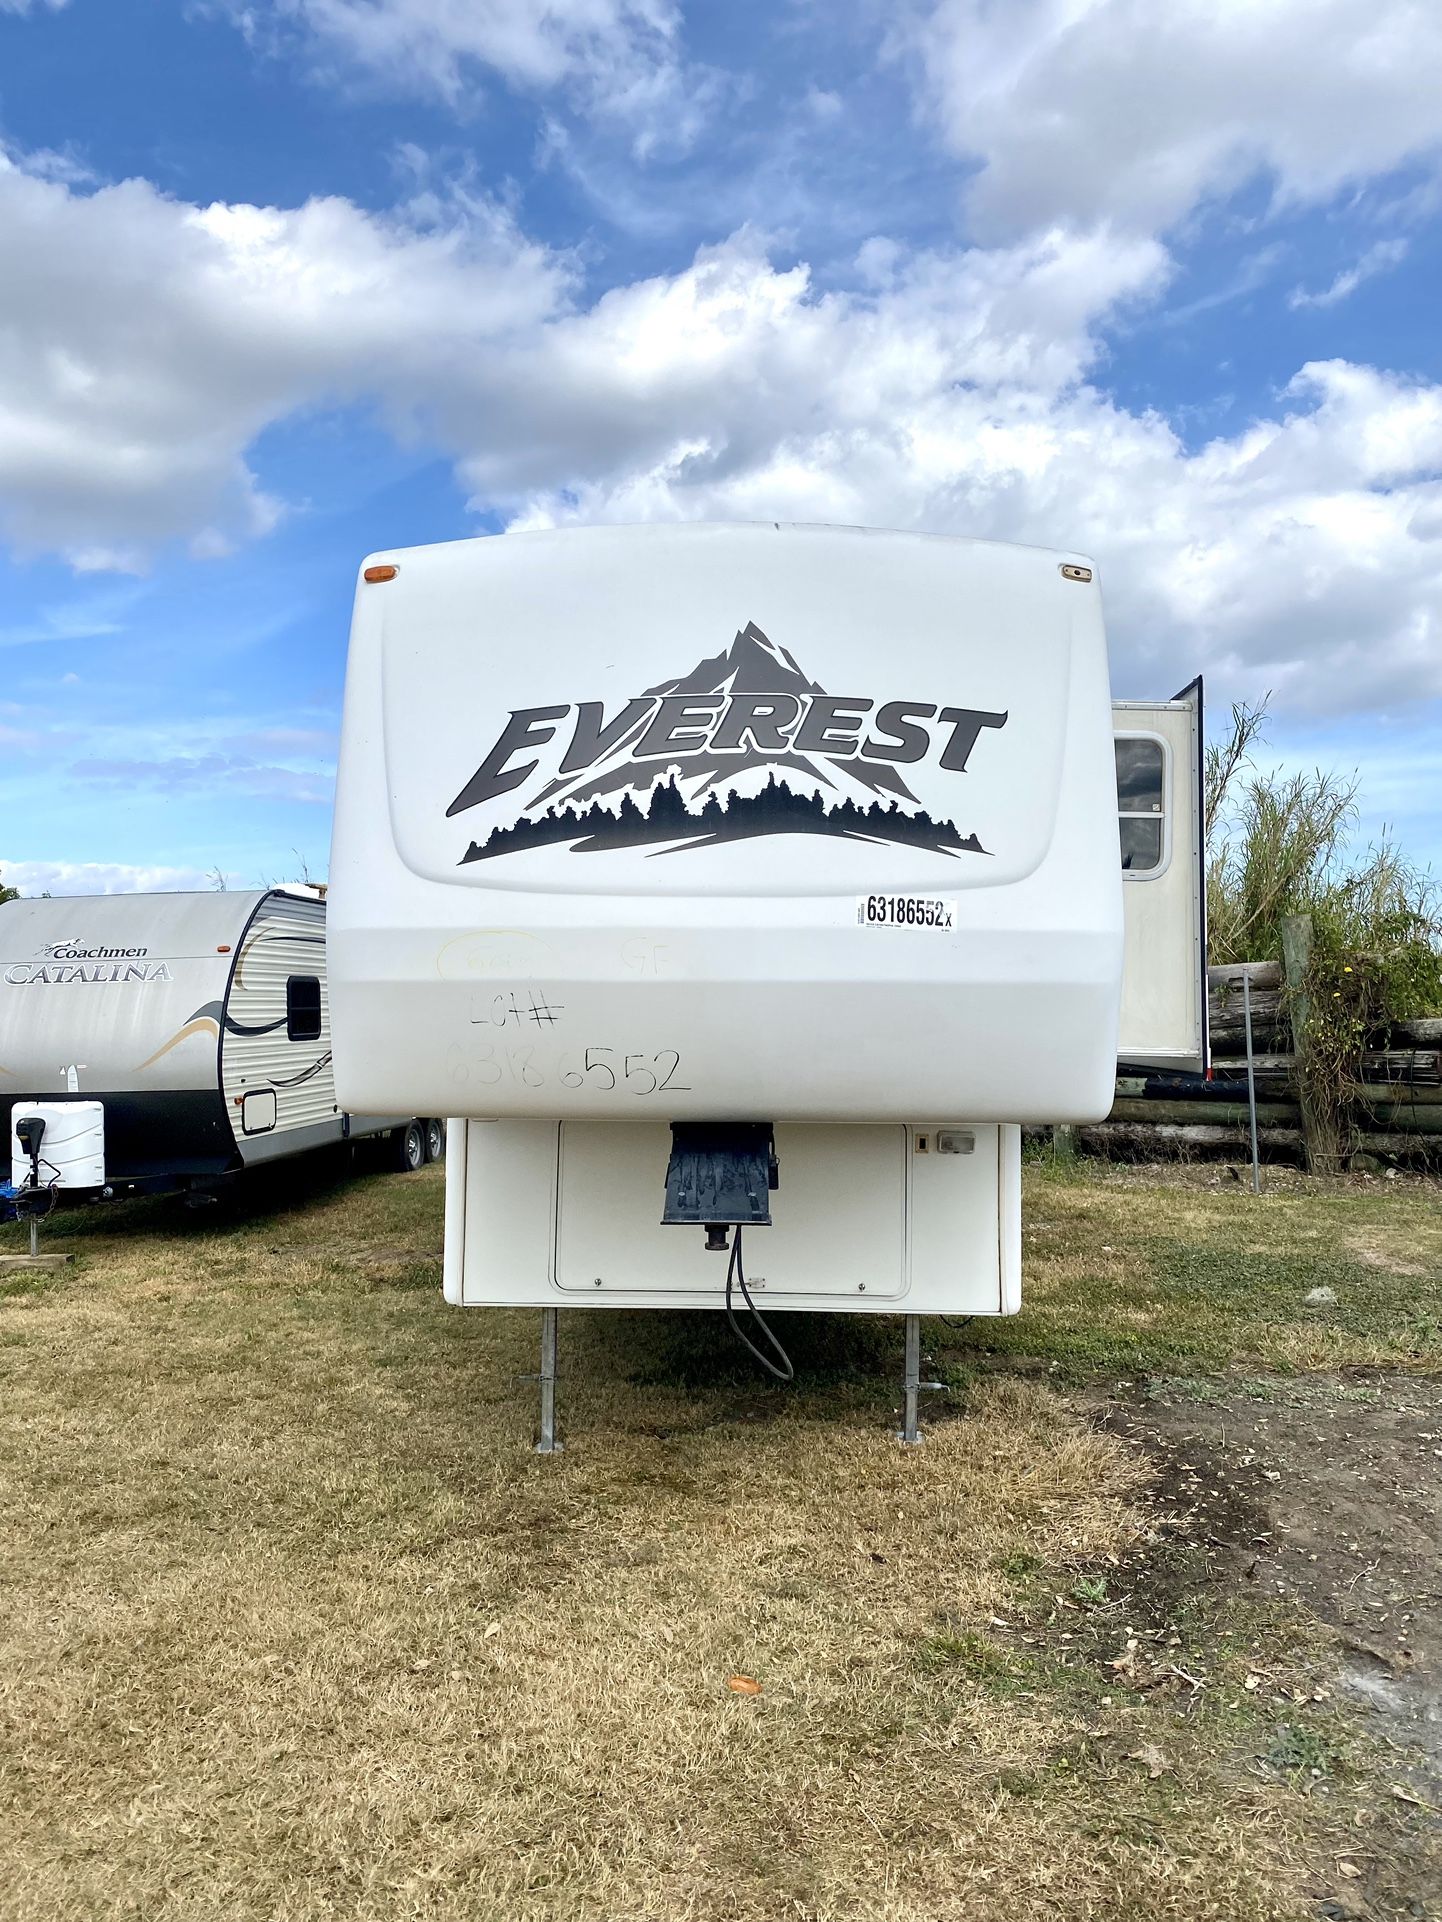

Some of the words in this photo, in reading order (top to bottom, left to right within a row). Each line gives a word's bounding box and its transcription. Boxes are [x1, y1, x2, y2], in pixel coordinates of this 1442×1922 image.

[445, 693, 1008, 817] EVEREST
[53, 946, 147, 959] Coachmen
[4, 962, 173, 986] CATALINA
